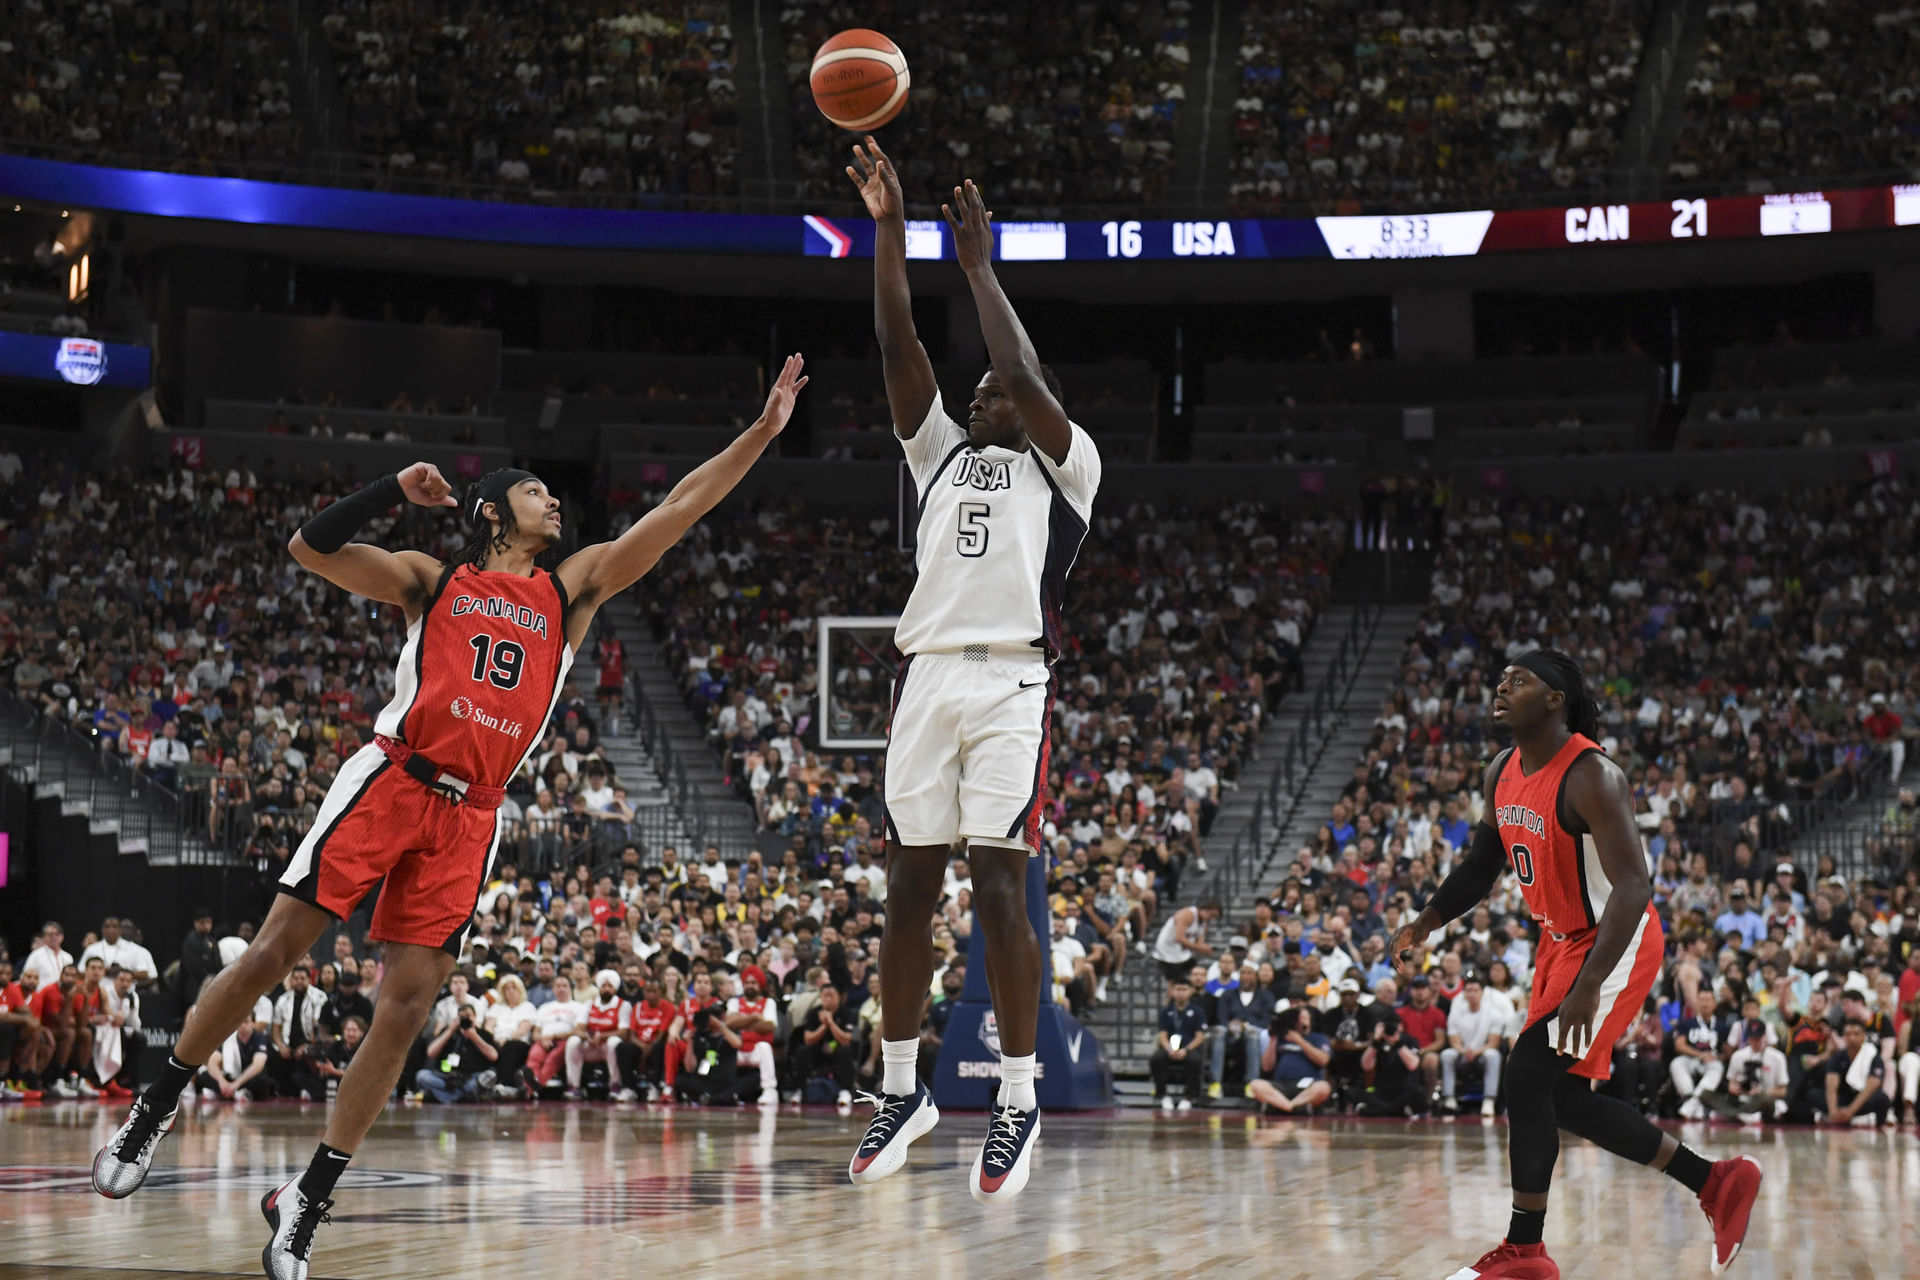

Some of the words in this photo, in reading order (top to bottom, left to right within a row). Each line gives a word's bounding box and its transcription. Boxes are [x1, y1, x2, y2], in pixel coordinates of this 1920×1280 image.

[823, 68, 865, 85] molten
[1381, 219, 1429, 243] 8:33
[1565, 205, 1629, 243] CAN
[1671, 198, 1708, 238] 21
[1101, 220, 1143, 258] 16
[1172, 221, 1236, 256] USA
[952, 456, 1011, 491] USA
[957, 502, 991, 558] 5
[451, 595, 547, 640] CANADA
[469, 633, 525, 691] 19
[473, 707, 498, 730] Sun
[499, 718, 523, 739] Life
[1511, 844, 1535, 887] 0
[958, 1061, 1044, 1079] SHOWE
